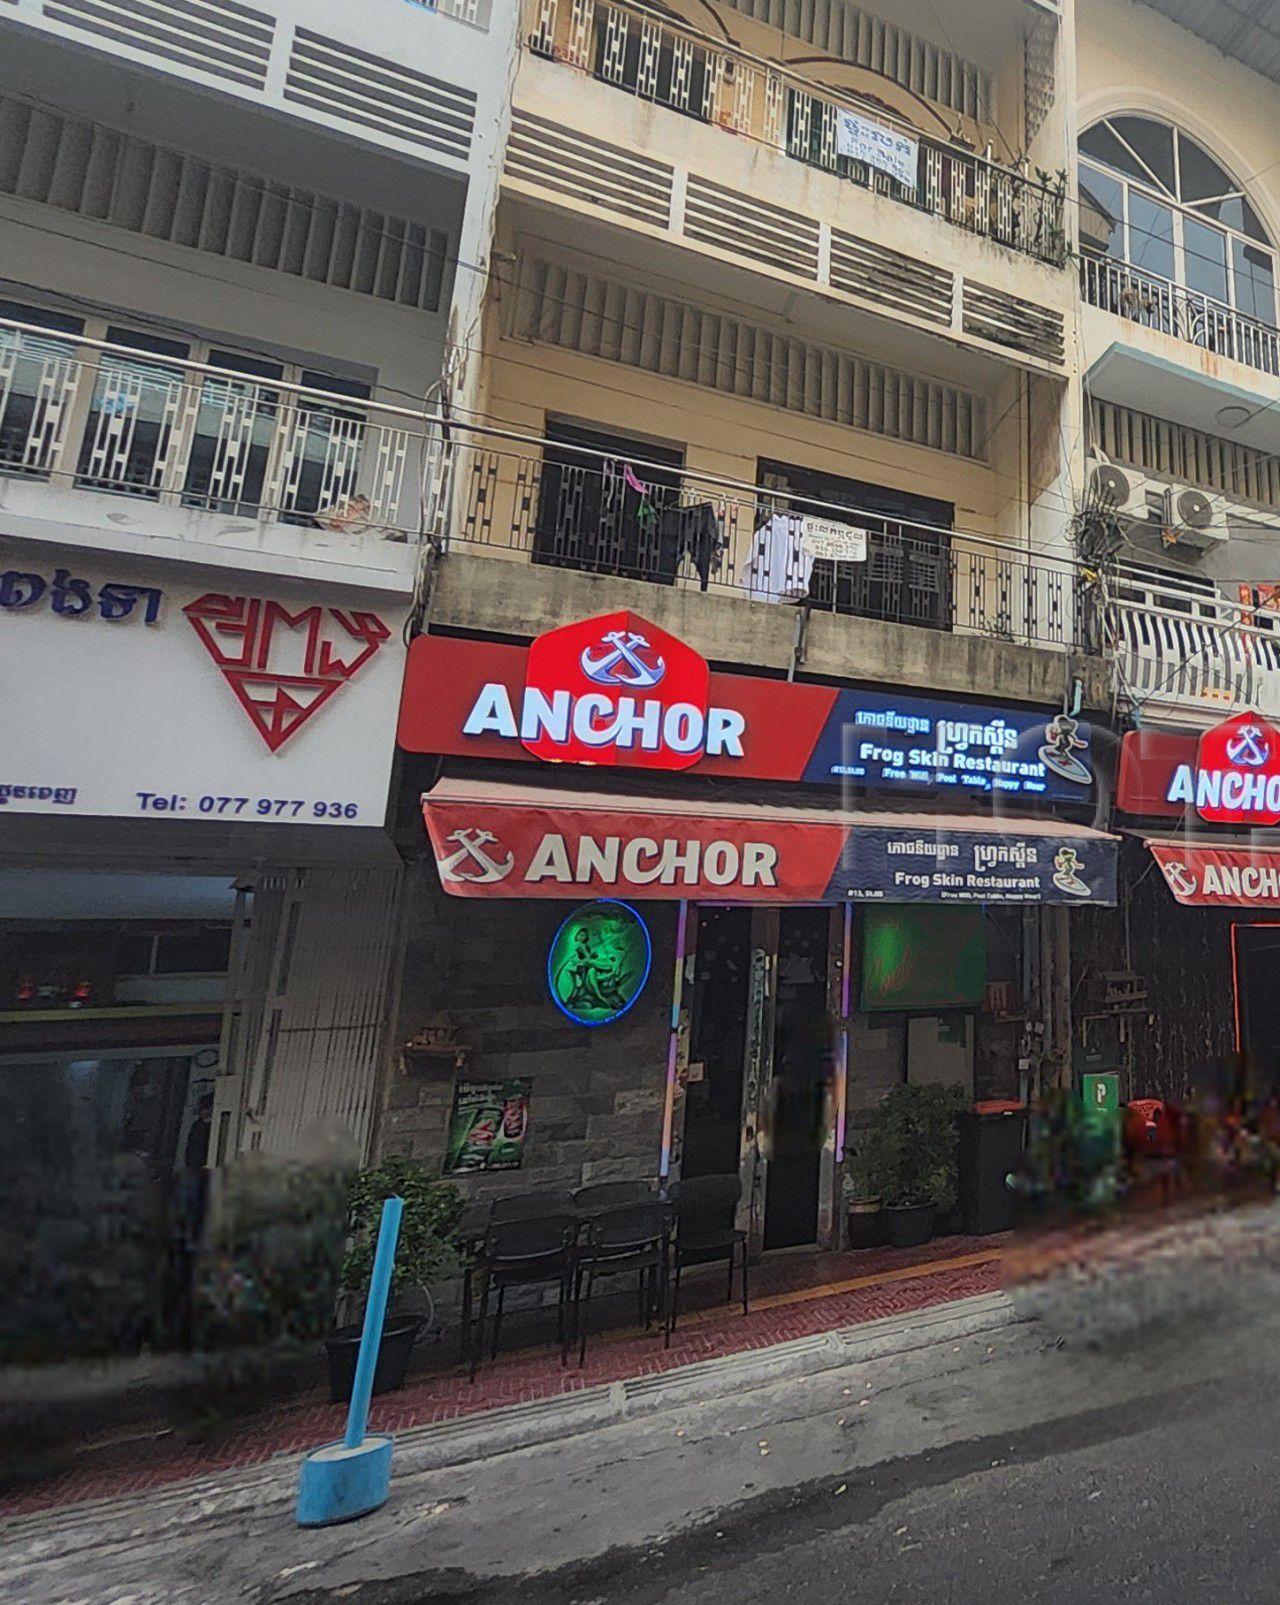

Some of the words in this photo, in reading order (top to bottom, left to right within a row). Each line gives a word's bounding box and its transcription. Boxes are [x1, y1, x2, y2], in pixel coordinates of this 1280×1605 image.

[462, 683, 746, 757] ANCHOR
[860, 743, 904, 766] Frog
[909, 749, 950, 767] Skin
[954, 754, 1046, 778] Restaurant
[136, 792, 187, 812] Tel:
[199, 796, 249, 815] 077
[256, 798, 305, 817] 977
[312, 801, 358, 819] 936
[524, 833, 779, 887] ANCHOR
[895, 872, 930, 889] Frog
[933, 873, 963, 887] Skin
[967, 874, 1041, 889] Restaurant
